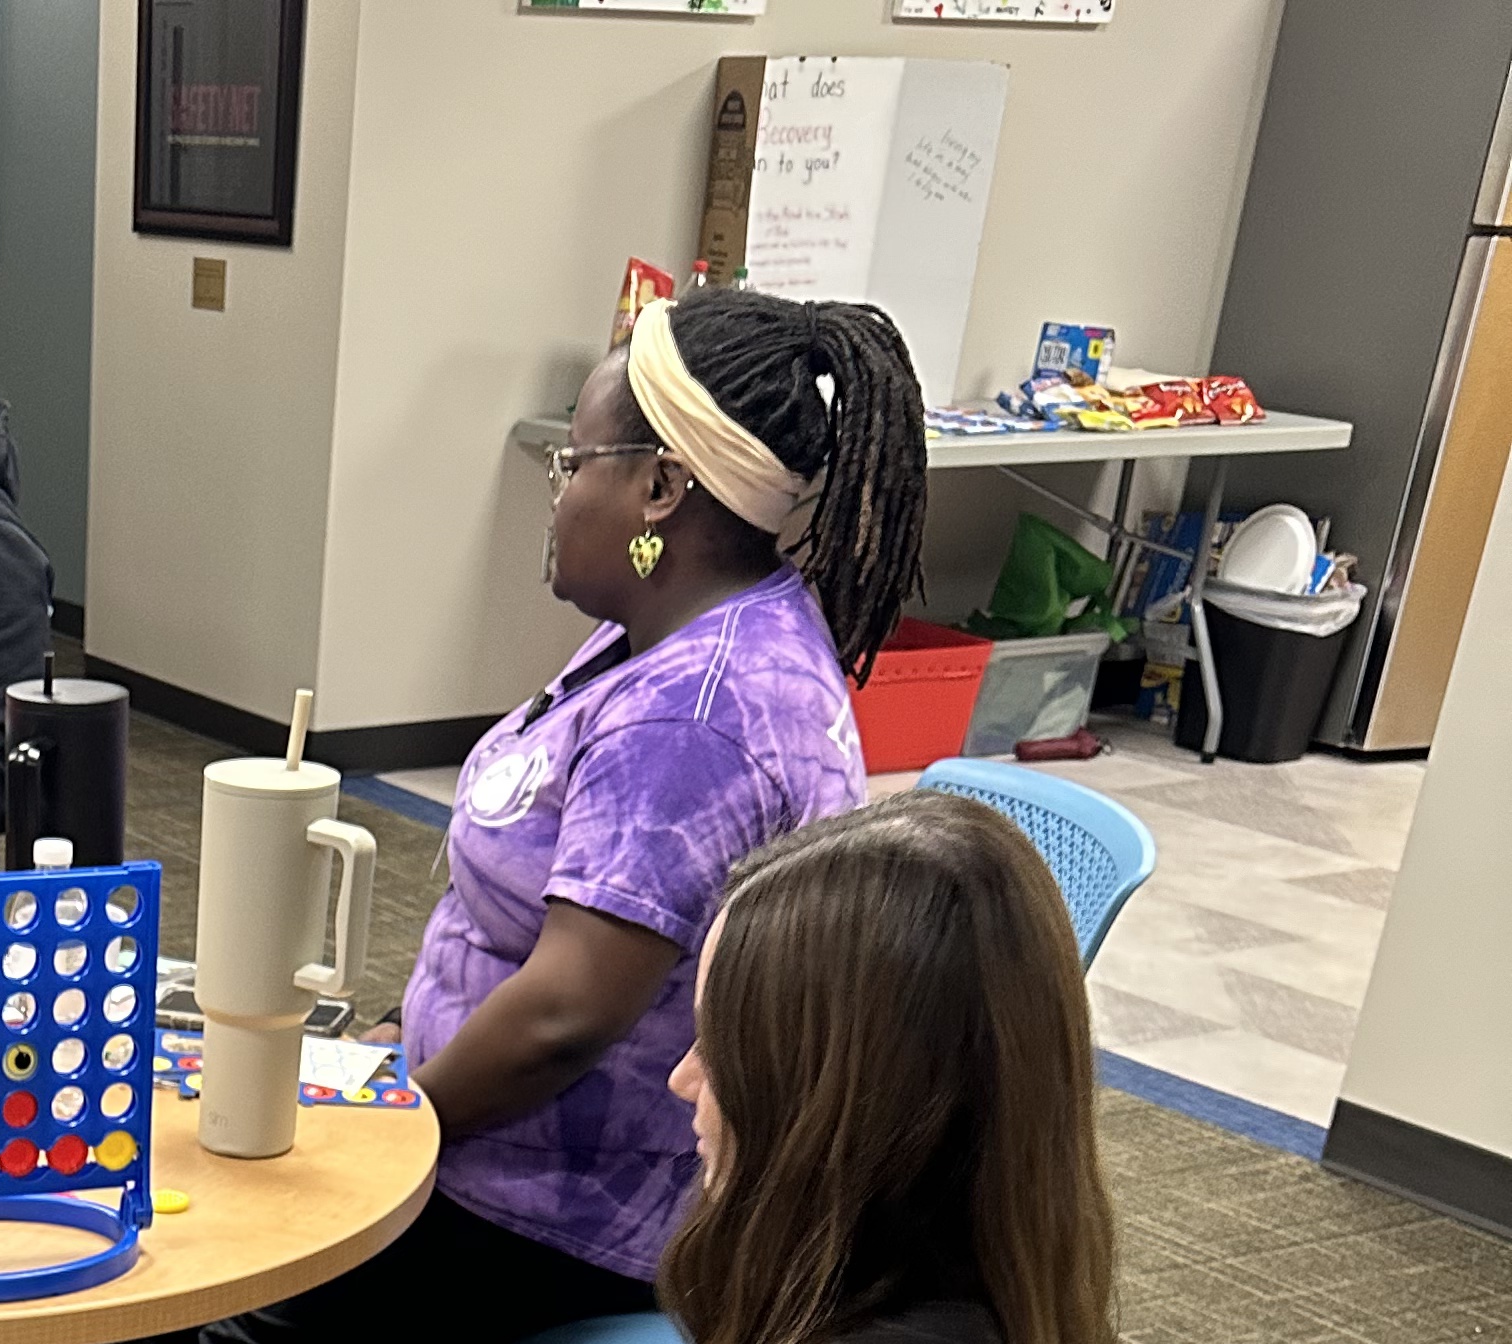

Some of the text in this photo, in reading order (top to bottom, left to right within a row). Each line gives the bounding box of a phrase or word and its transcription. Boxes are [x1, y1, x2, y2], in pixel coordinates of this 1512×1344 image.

[811, 71, 845, 98] does
[758, 107, 833, 151] Recovery
[778, 152, 794, 173] to
